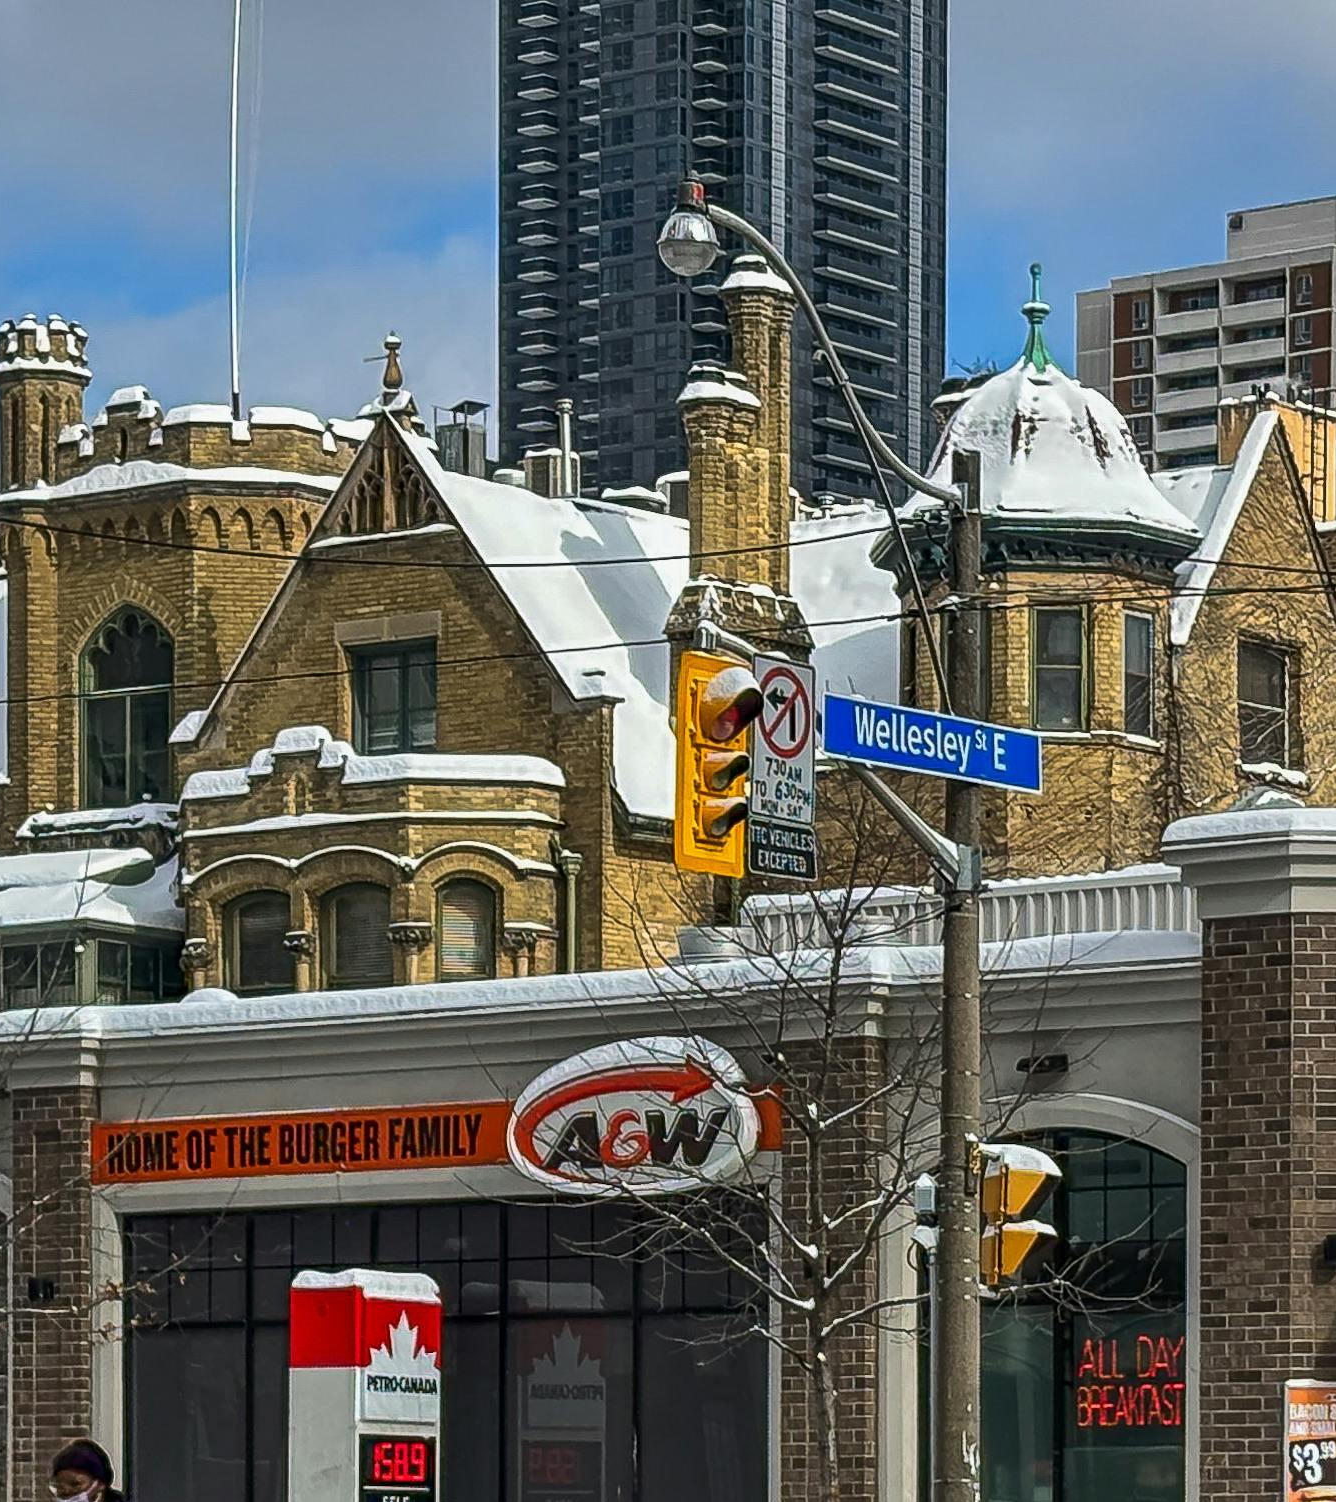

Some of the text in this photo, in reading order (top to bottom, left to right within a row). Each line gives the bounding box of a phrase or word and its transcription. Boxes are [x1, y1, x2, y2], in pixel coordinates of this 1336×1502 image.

[854, 705, 1007, 773] Wellesley St E
[754, 780, 767, 797] TO
[752, 825, 814, 852] TTC VEHICLES
[758, 849, 806, 873] EXCEPTED
[107, 1113, 483, 1175] HOME OF THE BURGER FAMILY
[541, 1108, 730, 1170] A&W
[1078, 1334, 1185, 1379] ALL DAY
[1076, 1383, 1186, 1428] BREAKFAST
